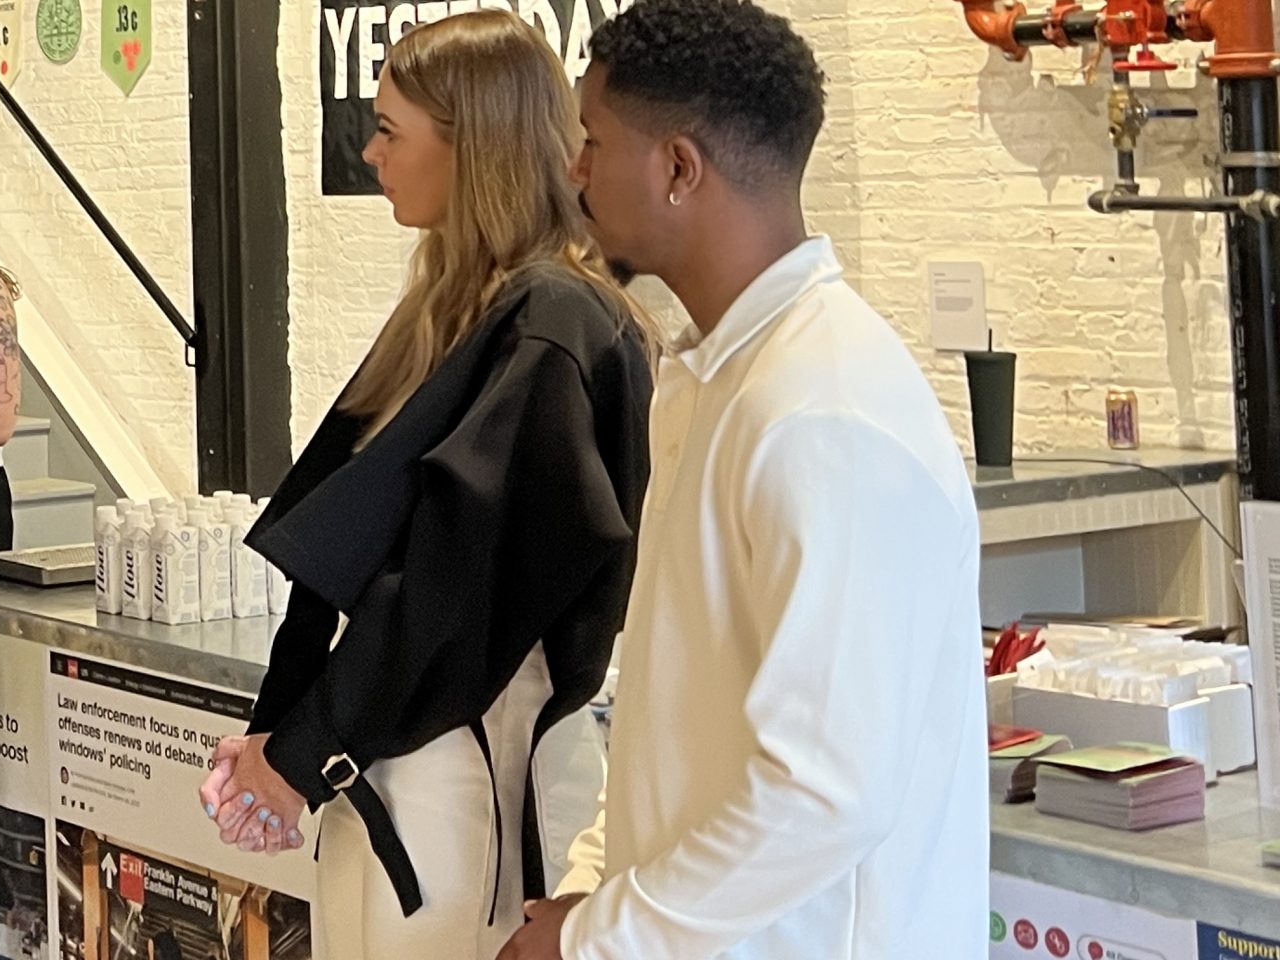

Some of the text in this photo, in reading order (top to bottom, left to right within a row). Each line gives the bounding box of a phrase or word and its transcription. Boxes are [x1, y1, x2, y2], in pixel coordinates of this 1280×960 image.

[6, 713, 19, 733] to
[58, 692, 222, 750] Law enforcement focus on qua
[58, 716, 101, 740] offenses
[104, 728, 142, 752] renews
[145, 740, 162, 758] old
[165, 745, 204, 769] debate
[58, 739, 151, 780] windows' policing
[120, 853, 143, 877] Exit
[144, 862, 175, 887] Franklin
[178, 875, 208, 898] Avenue
[144, 876, 213, 916] Eastern Parkway
